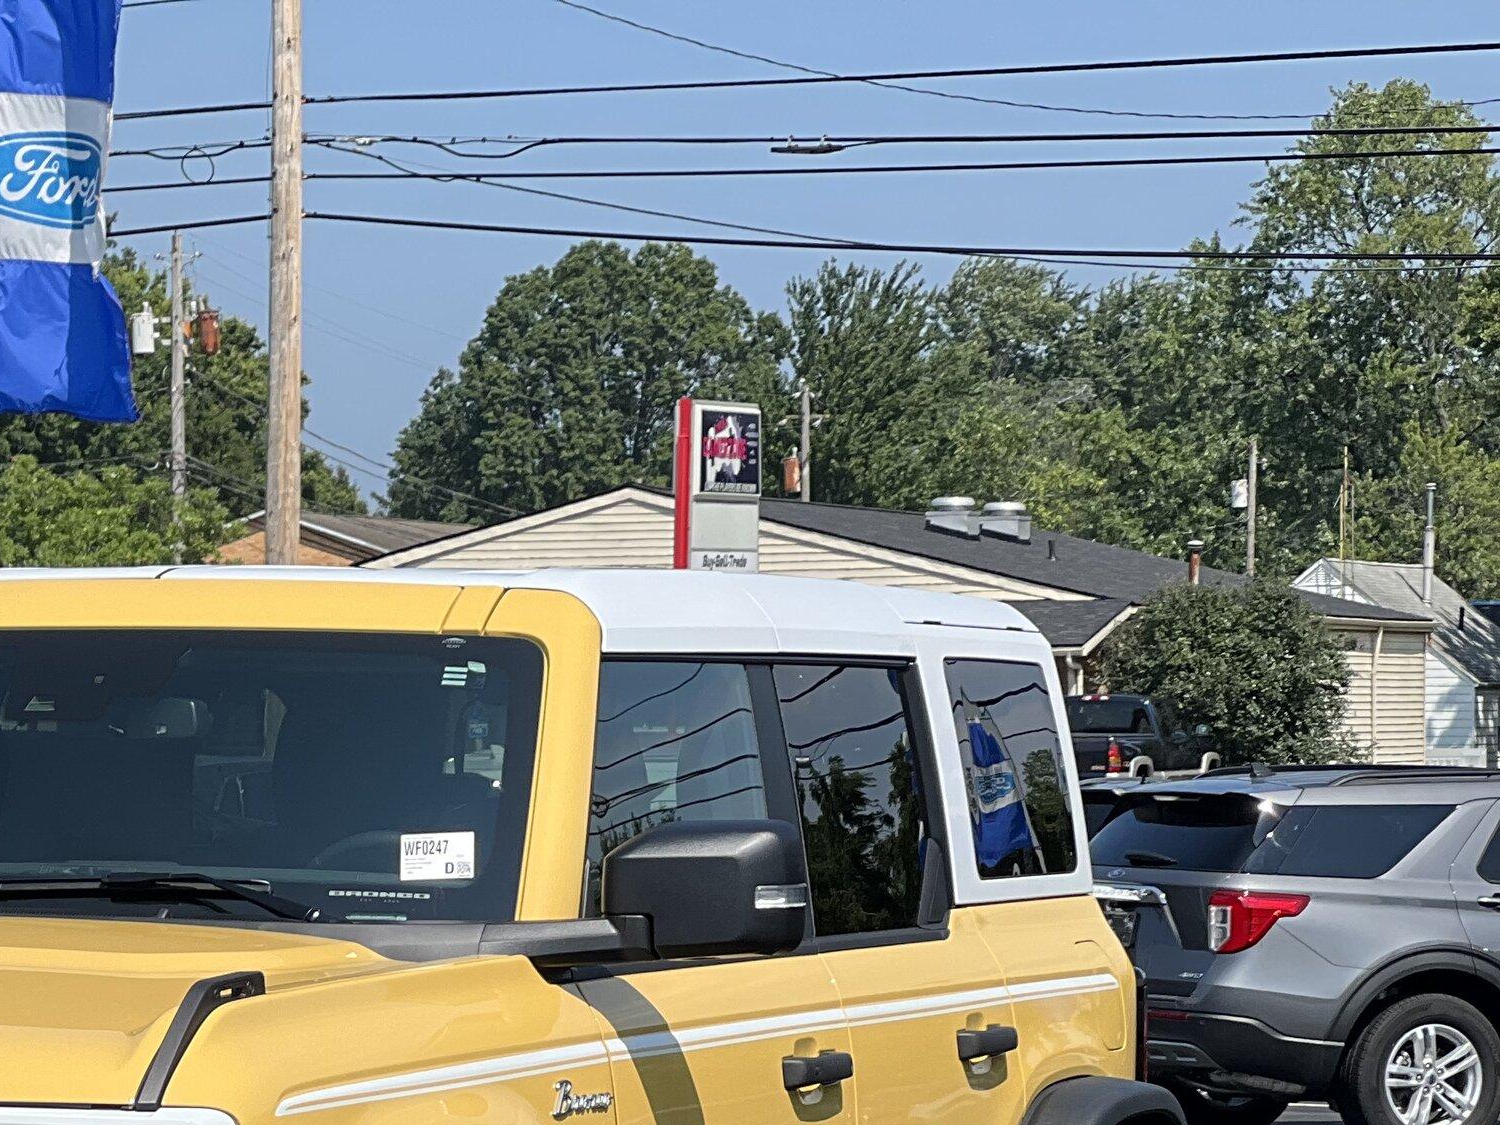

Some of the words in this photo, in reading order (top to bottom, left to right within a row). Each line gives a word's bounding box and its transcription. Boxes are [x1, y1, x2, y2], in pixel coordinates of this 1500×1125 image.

[404, 840, 449, 856] WF0247
[445, 862, 455, 874] D
[328, 890, 431, 899] BRONCO
